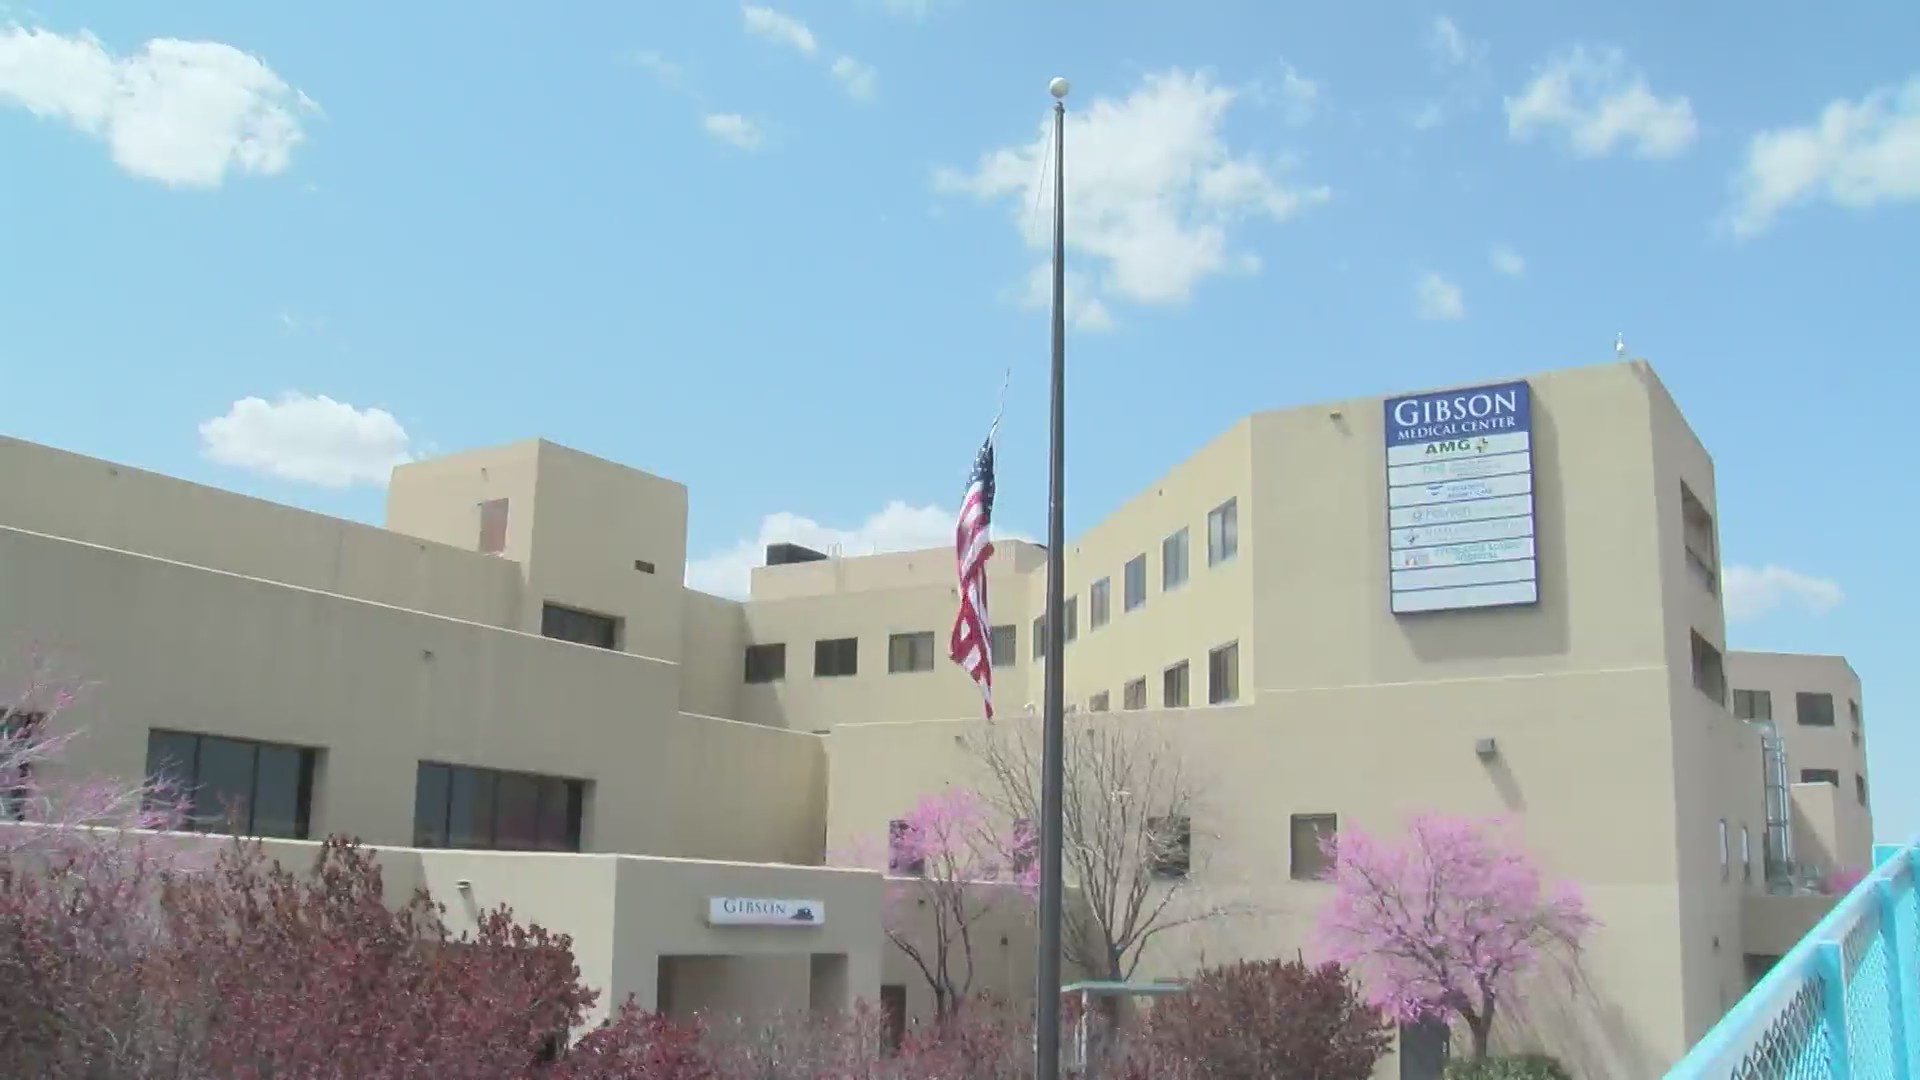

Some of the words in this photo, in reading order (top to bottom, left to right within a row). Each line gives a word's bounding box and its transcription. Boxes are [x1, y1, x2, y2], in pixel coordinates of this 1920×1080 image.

[1394, 391, 1516, 426] GIBSON
[1397, 424, 1457, 441] MEDICAL
[1461, 416, 1516, 433] CENTER
[1425, 438, 1471, 454] AMG
[723, 898, 786, 914] GIBSON
